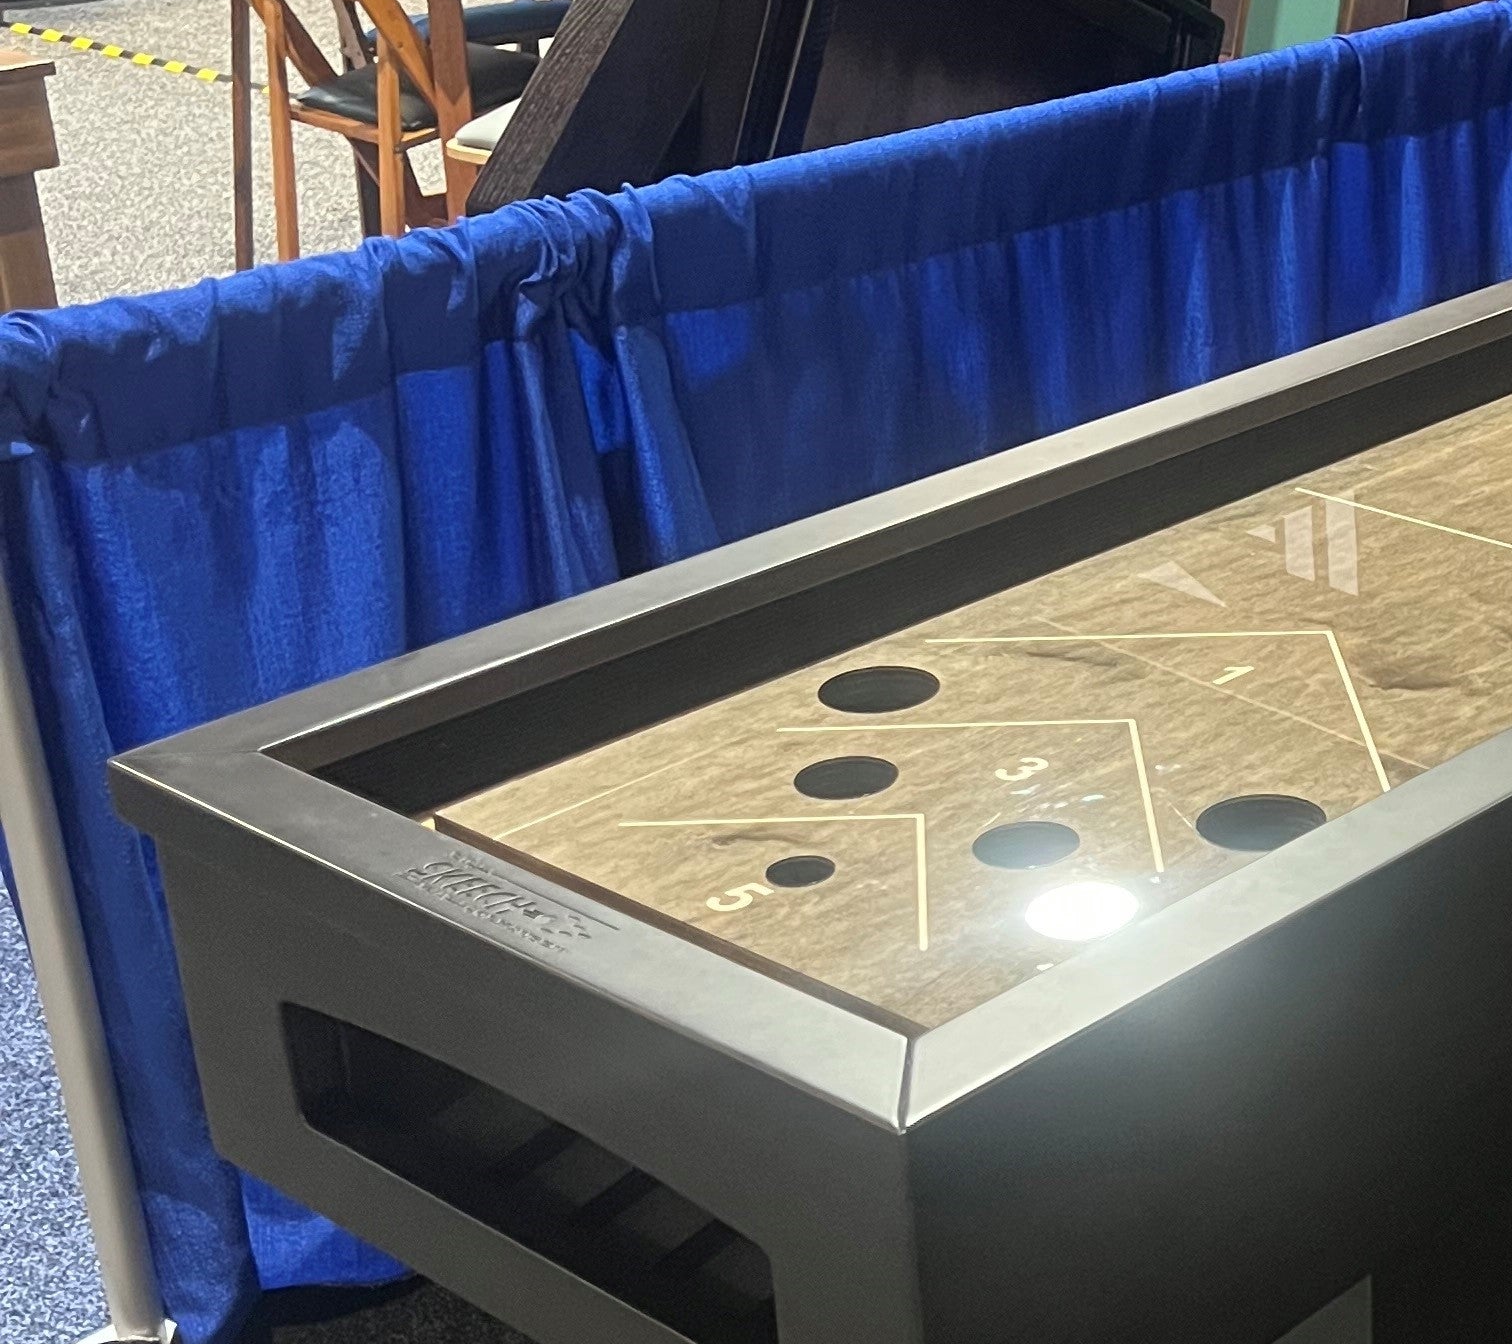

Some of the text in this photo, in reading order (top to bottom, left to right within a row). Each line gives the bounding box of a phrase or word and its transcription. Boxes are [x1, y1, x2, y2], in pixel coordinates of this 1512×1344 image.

[1212, 665, 1255, 685] 1
[993, 757, 1050, 781] 3
[705, 882, 776, 912] 5
